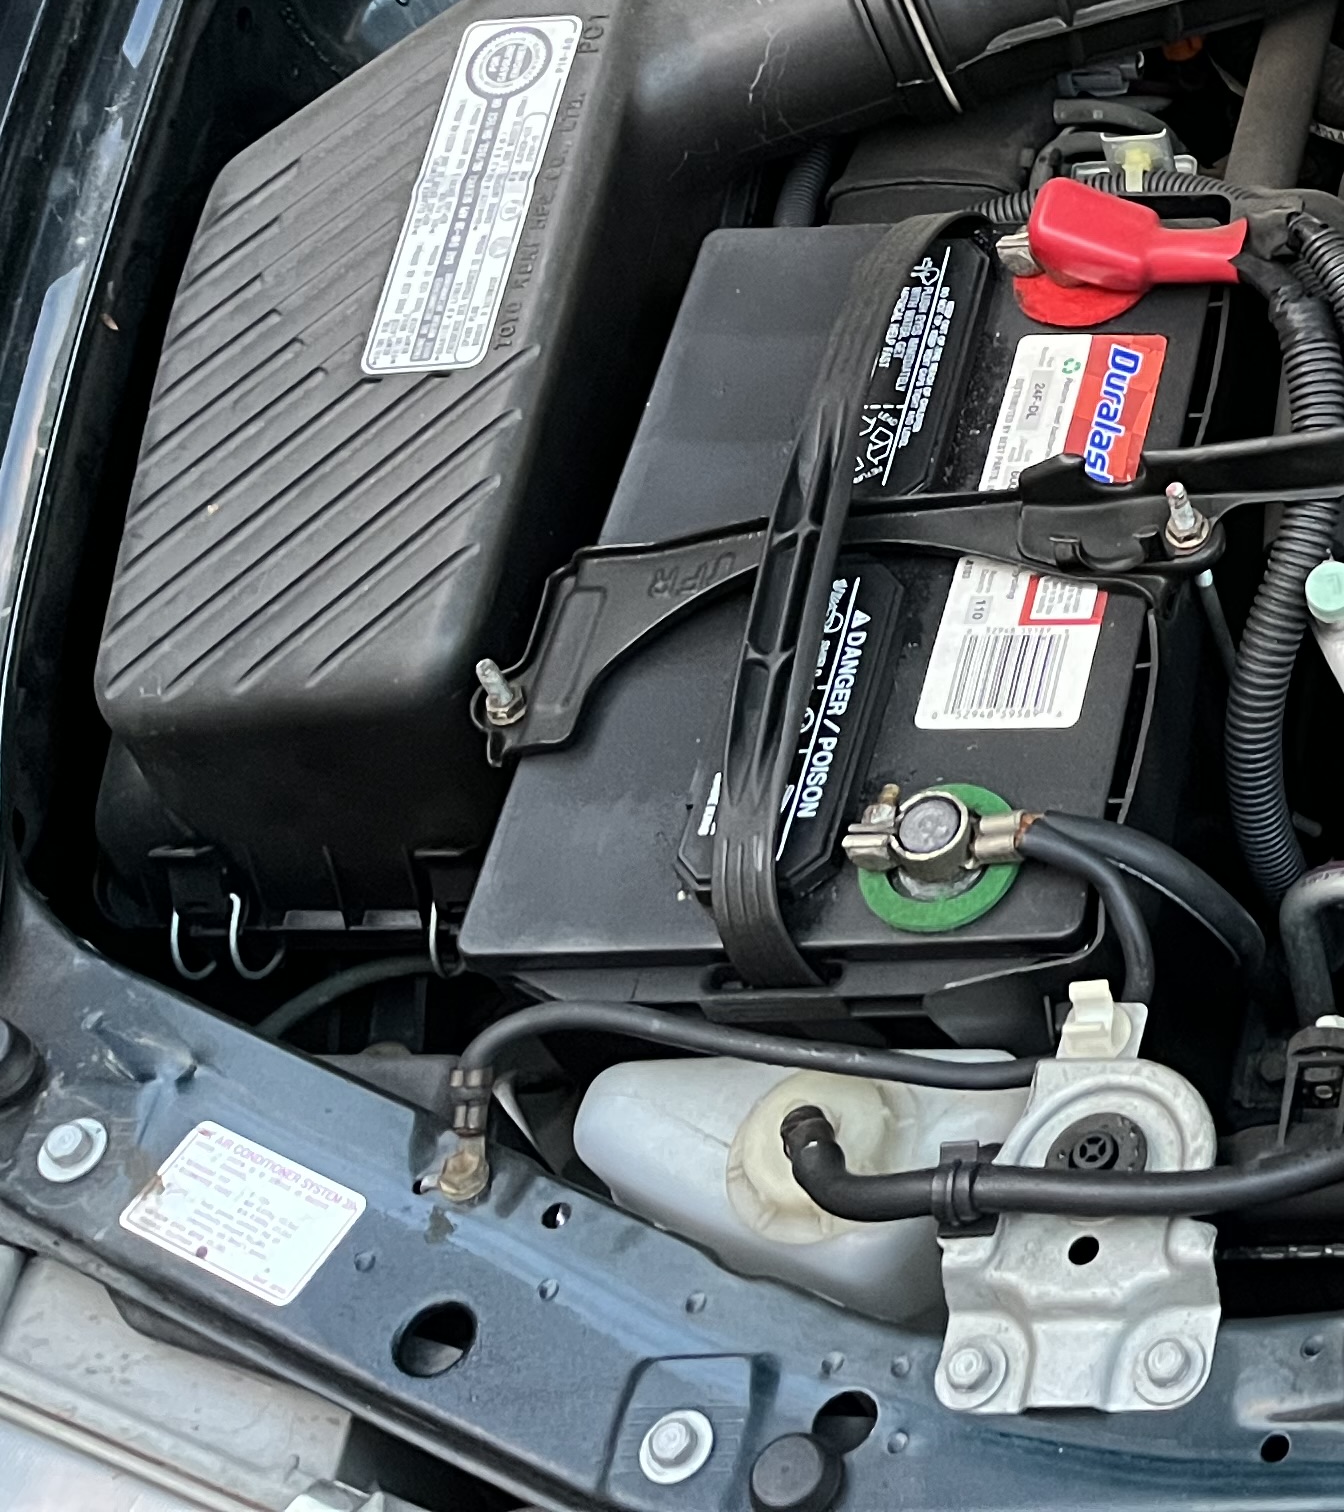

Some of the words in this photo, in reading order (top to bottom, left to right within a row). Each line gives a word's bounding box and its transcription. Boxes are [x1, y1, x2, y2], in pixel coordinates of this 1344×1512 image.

[885, 322, 900, 346] HELP
[878, 346, 894, 368] FAST
[1025, 382, 1046, 420] 24F-DL
[971, 600, 987, 620] 110
[825, 630, 868, 716] DANGER
[822, 718, 841, 734] /
[796, 736, 839, 819] POISON
[213, 1134, 236, 1151] AIR
[230, 1142, 304, 1185] CONDITIONER
[298, 1176, 345, 1206] SYSTEM
